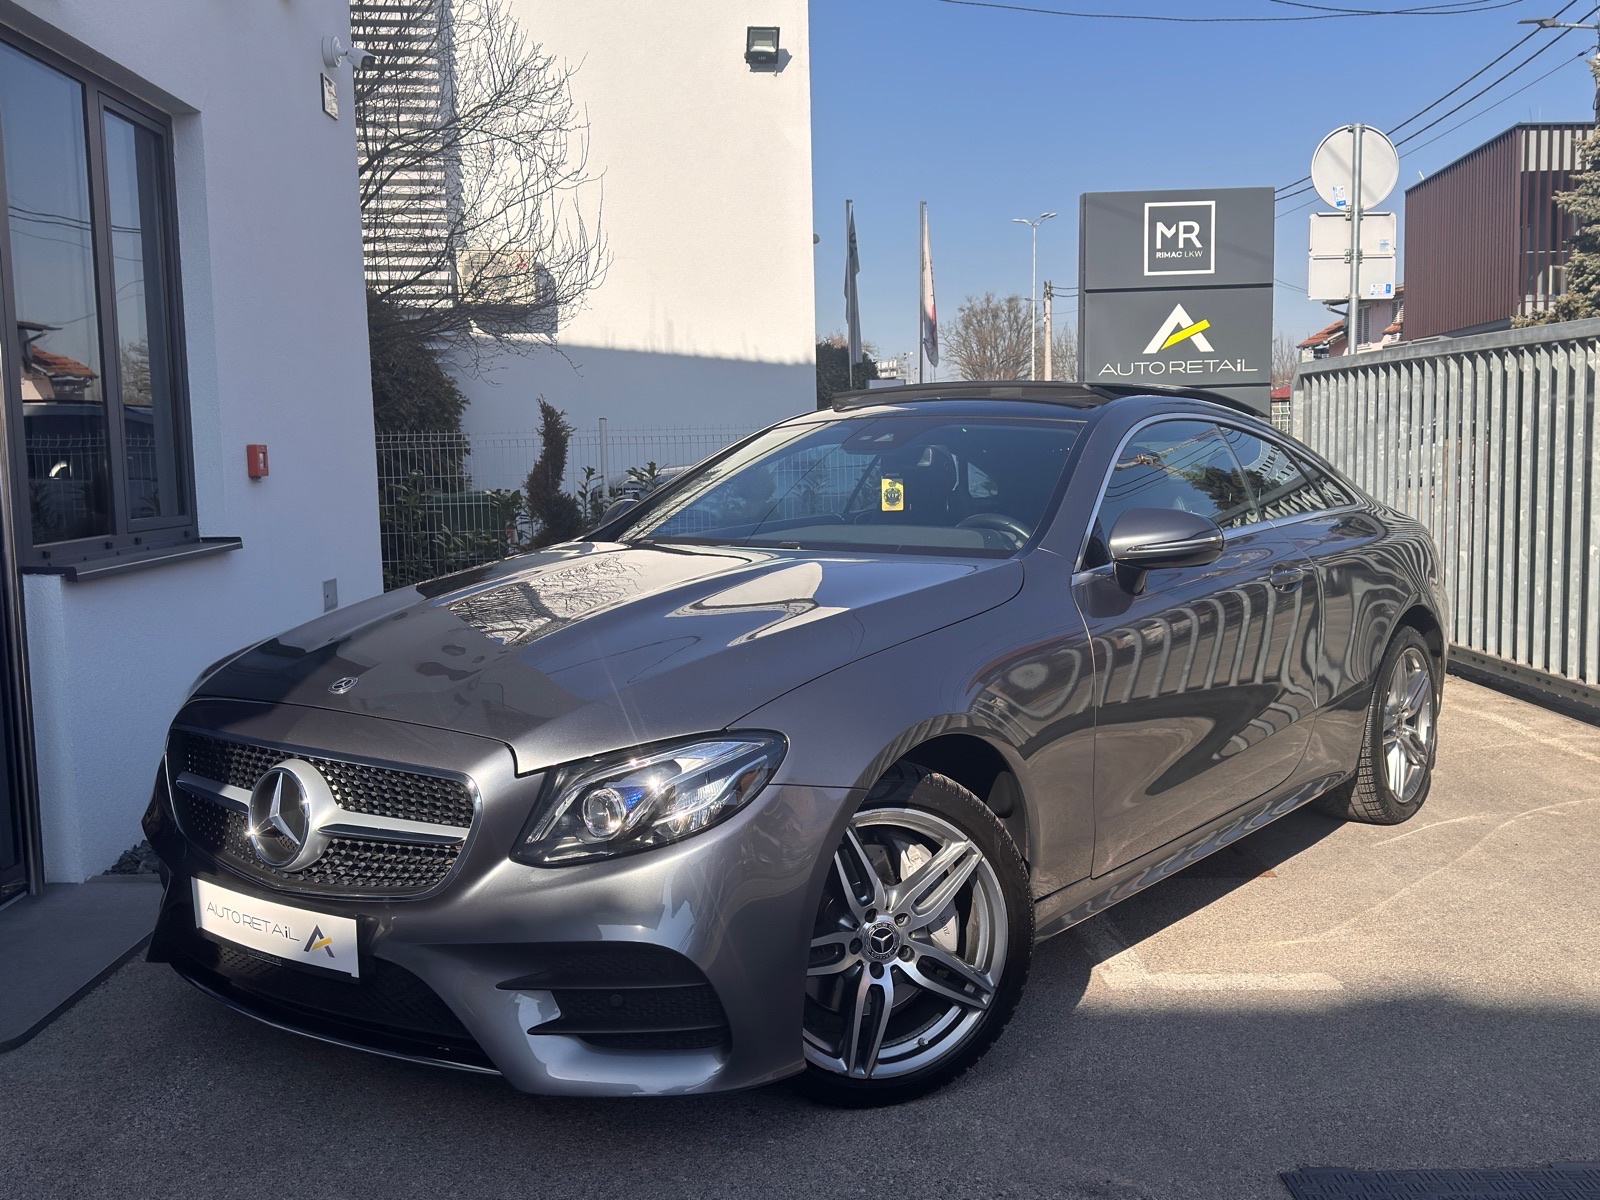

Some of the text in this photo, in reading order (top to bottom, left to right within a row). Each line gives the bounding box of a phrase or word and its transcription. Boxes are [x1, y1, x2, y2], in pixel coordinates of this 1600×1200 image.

[1156, 220, 1203, 249] MR
[1156, 250, 1203, 259] RIMAC LKW
